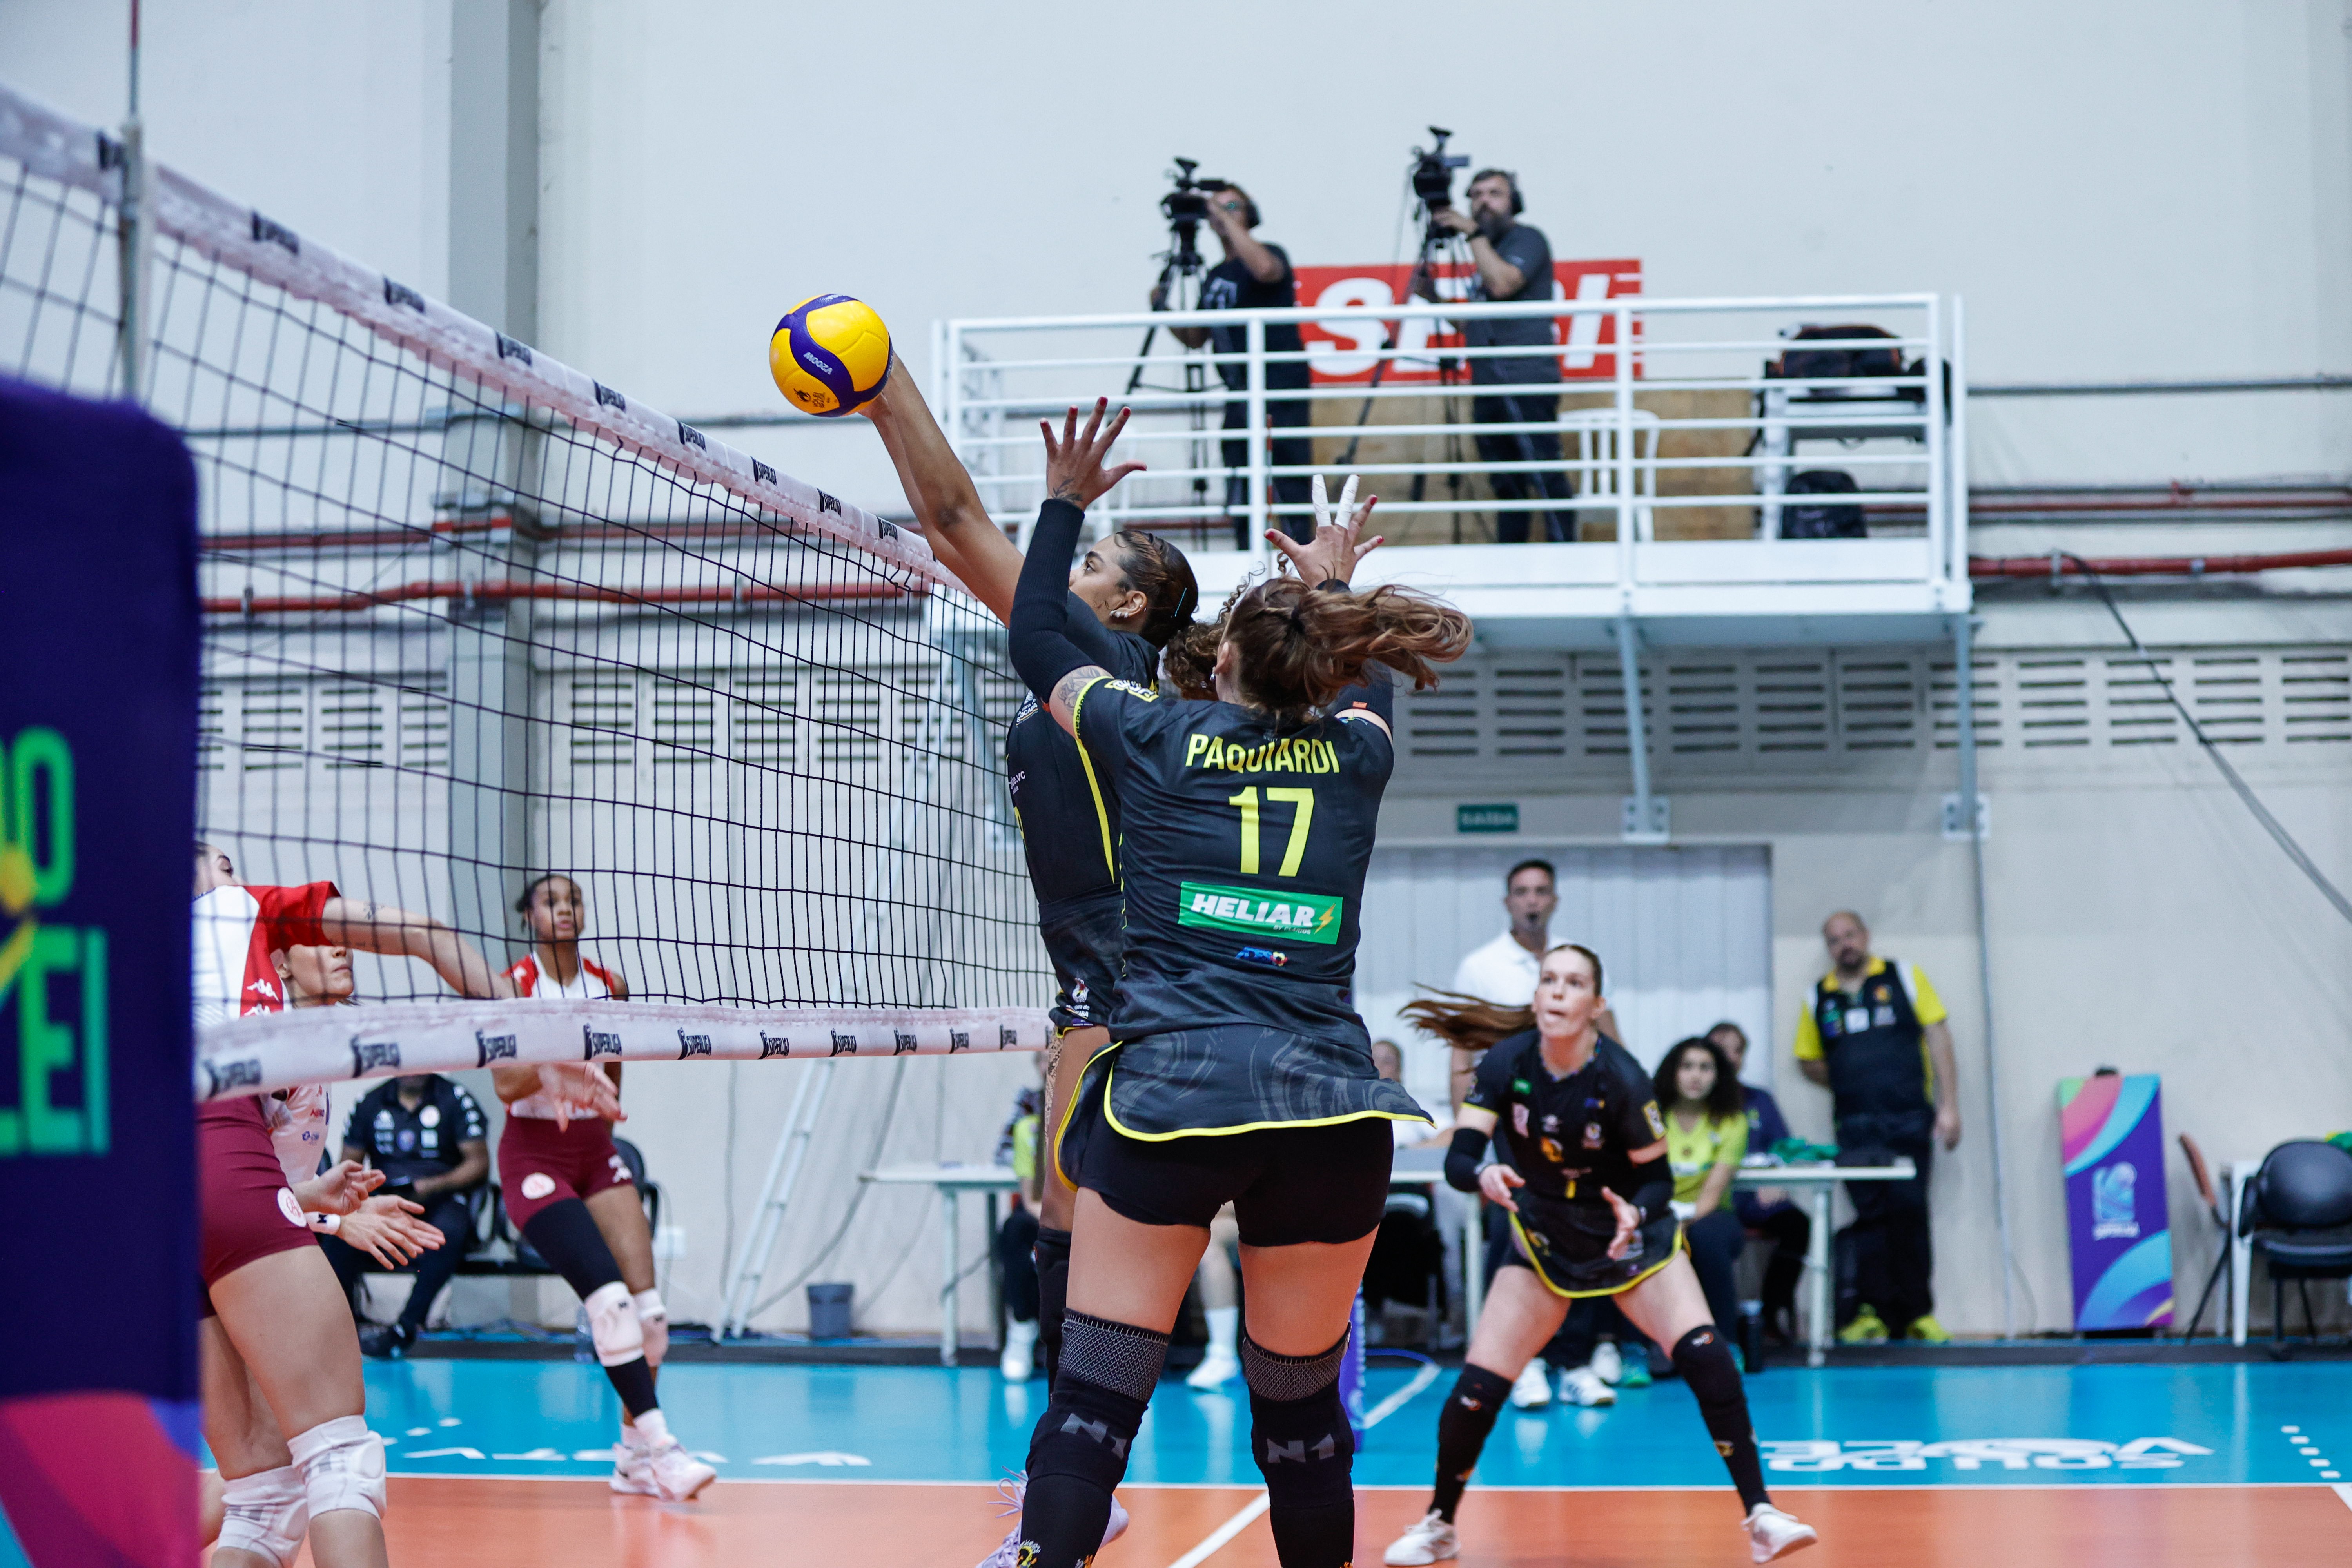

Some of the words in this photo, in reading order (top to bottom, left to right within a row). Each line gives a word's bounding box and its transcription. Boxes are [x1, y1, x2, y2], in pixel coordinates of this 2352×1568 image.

[1185, 733, 1341, 774] PAQUIARDI
[1229, 786, 1315, 877] 17
[1191, 893, 1316, 927] HELIAR
[767, 1037, 789, 1058] SUPERLIGA
[837, 1035, 857, 1054] SUPERLIGA
